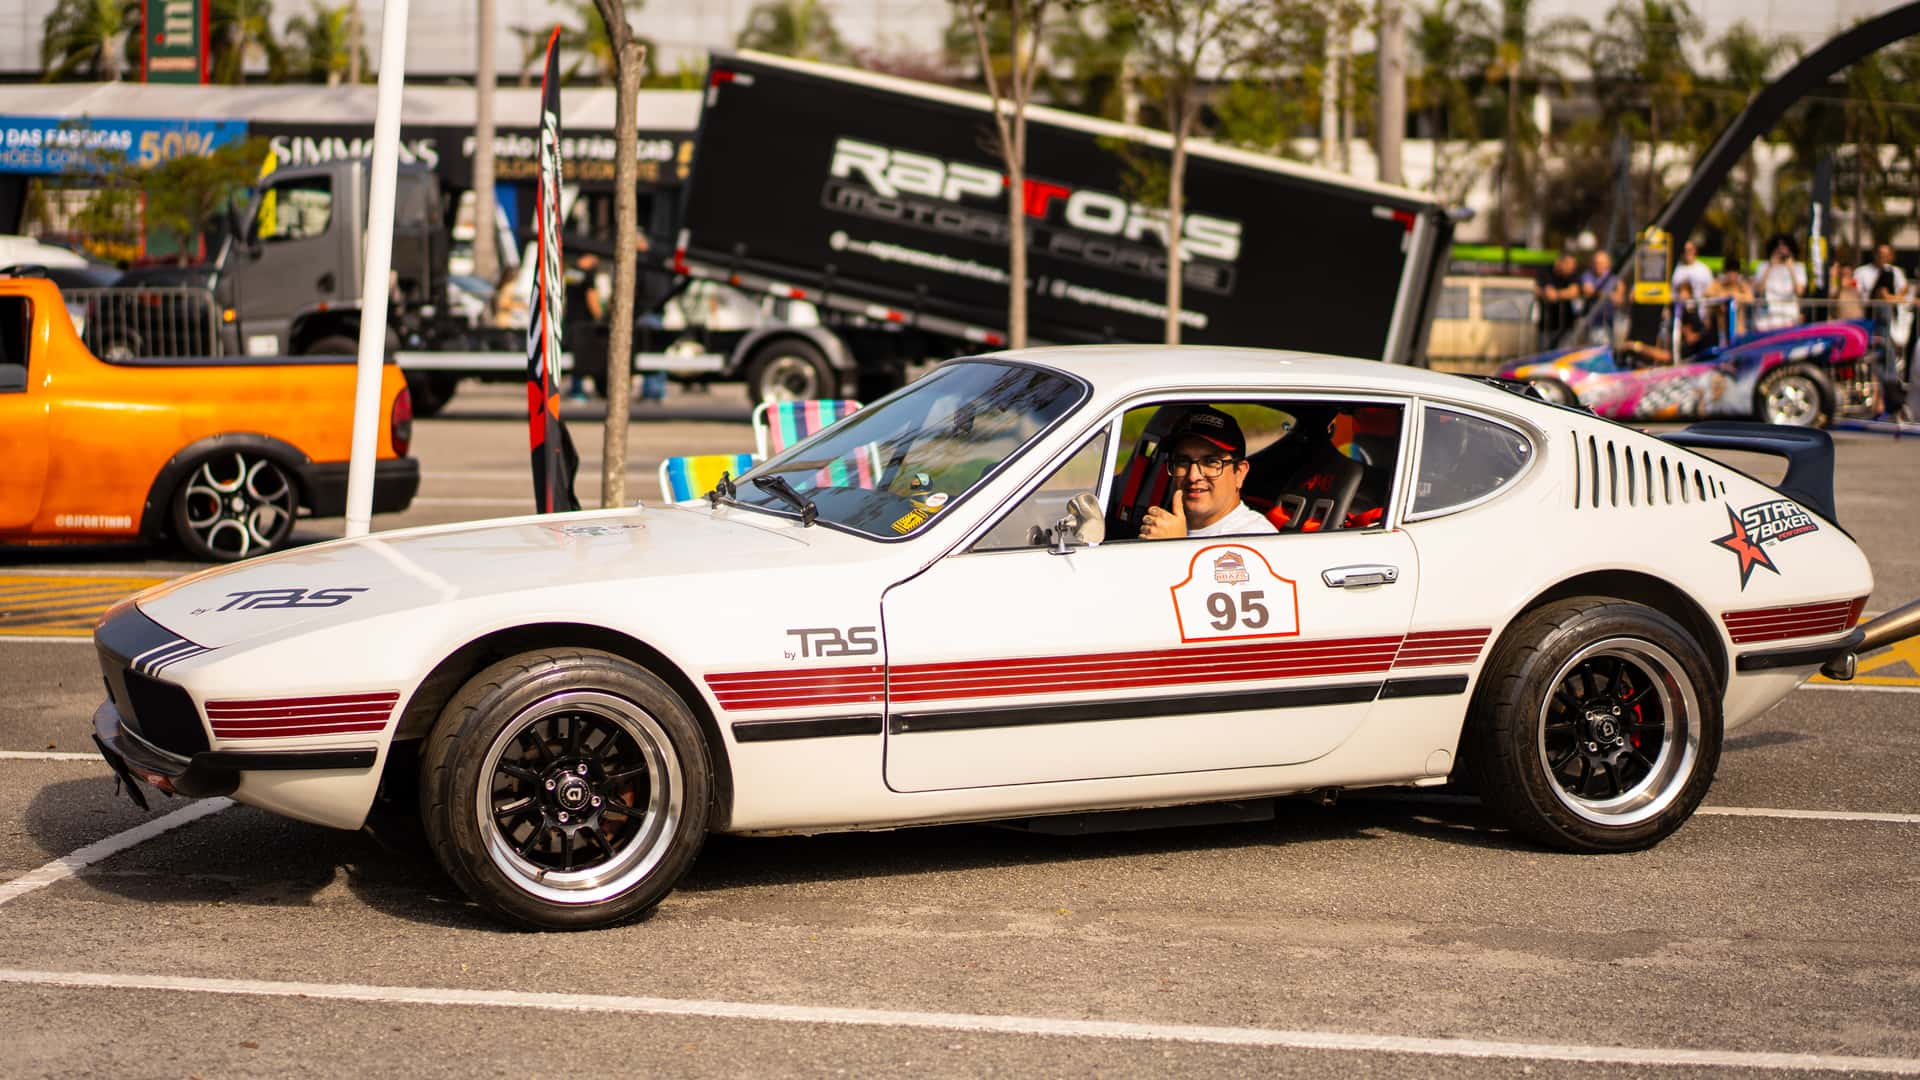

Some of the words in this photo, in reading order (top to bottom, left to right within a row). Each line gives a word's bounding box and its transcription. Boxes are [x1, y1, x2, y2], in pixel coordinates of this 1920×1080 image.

[1743, 501, 1800, 529] STAR
[1760, 514, 1812, 539] BOXER
[216, 588, 371, 612] TBS
[1206, 590, 1270, 631] 95
[786, 626, 879, 658] TBS
[784, 650, 796, 661] by
